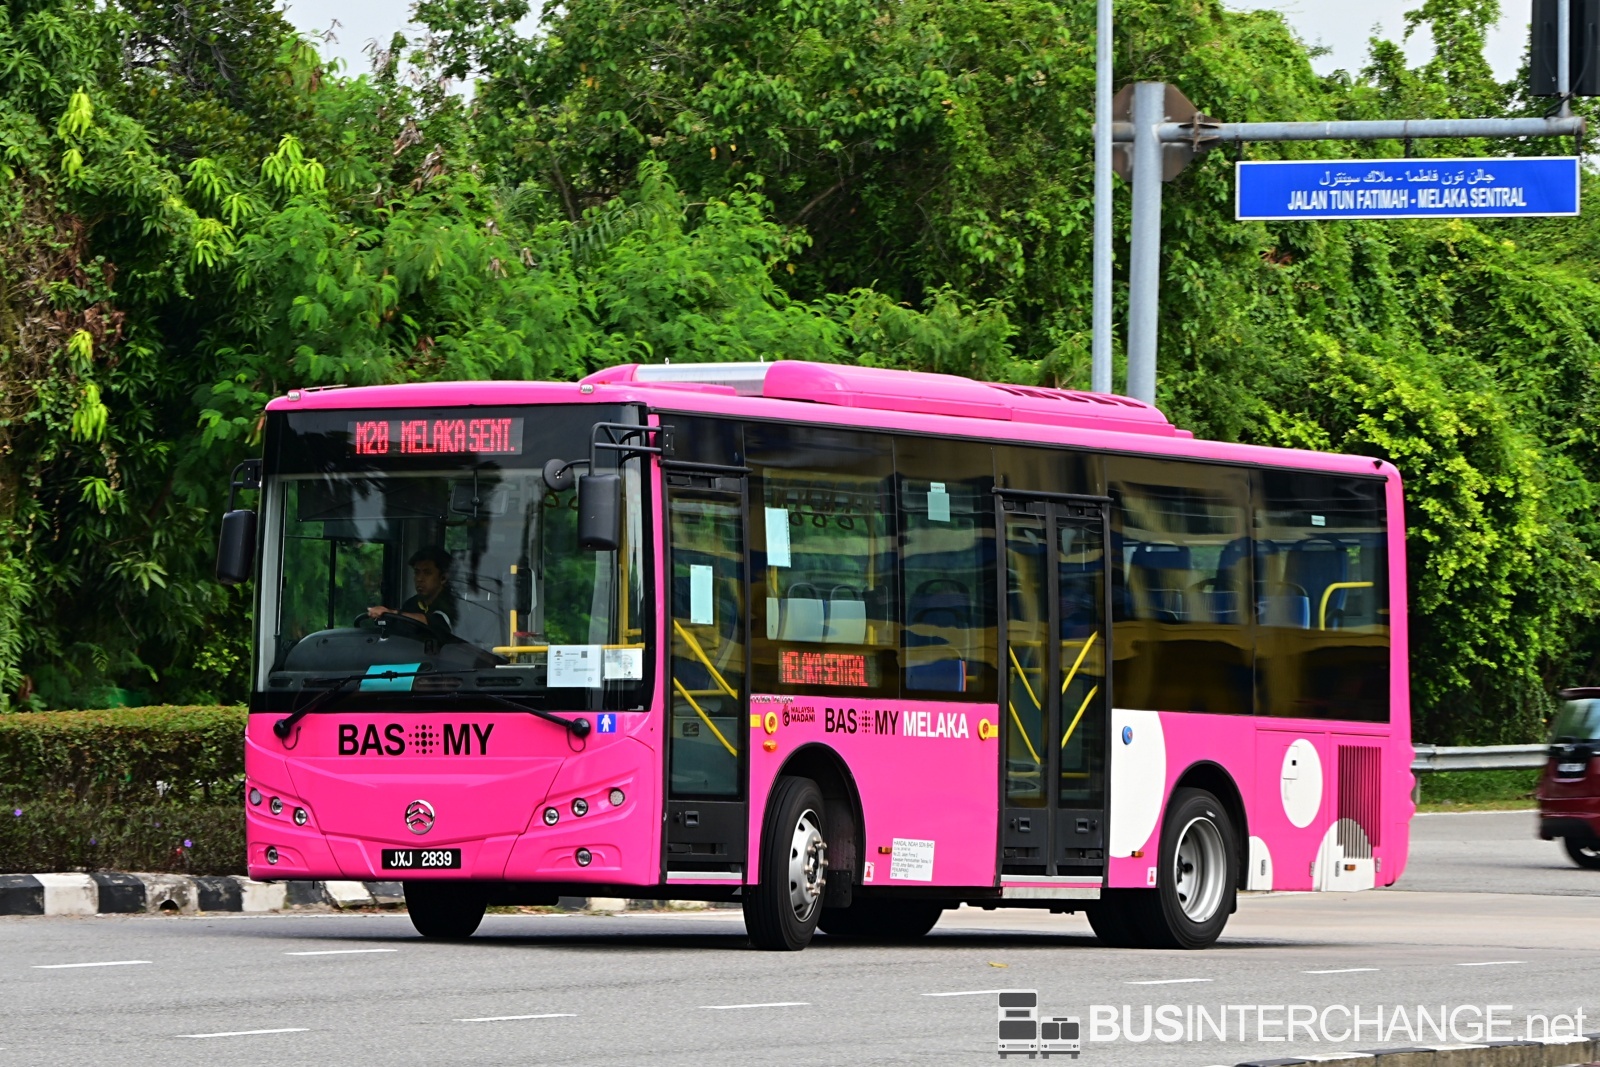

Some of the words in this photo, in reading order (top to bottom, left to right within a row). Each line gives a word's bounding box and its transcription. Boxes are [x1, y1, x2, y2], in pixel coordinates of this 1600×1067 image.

[1287, 190, 1328, 210] JALAN
[1329, 189, 1355, 210] TUN
[1356, 188, 1409, 209] FATIMAH
[1417, 188, 1469, 208] MELAKA
[1469, 187, 1527, 207] SENTRAL
[401, 419, 466, 453] MELAKA
[469, 418, 515, 452] SENT.
[791, 706, 815, 714] MALAYSIA
[791, 714, 816, 723] MADANI
[825, 708, 858, 735] BAS
[875, 710, 899, 735] MY
[903, 711, 969, 738] MELAKA
[338, 723, 406, 756] BAS
[443, 723, 495, 756] MY
[390, 851, 413, 867] JXJ
[421, 851, 453, 867] 2839
